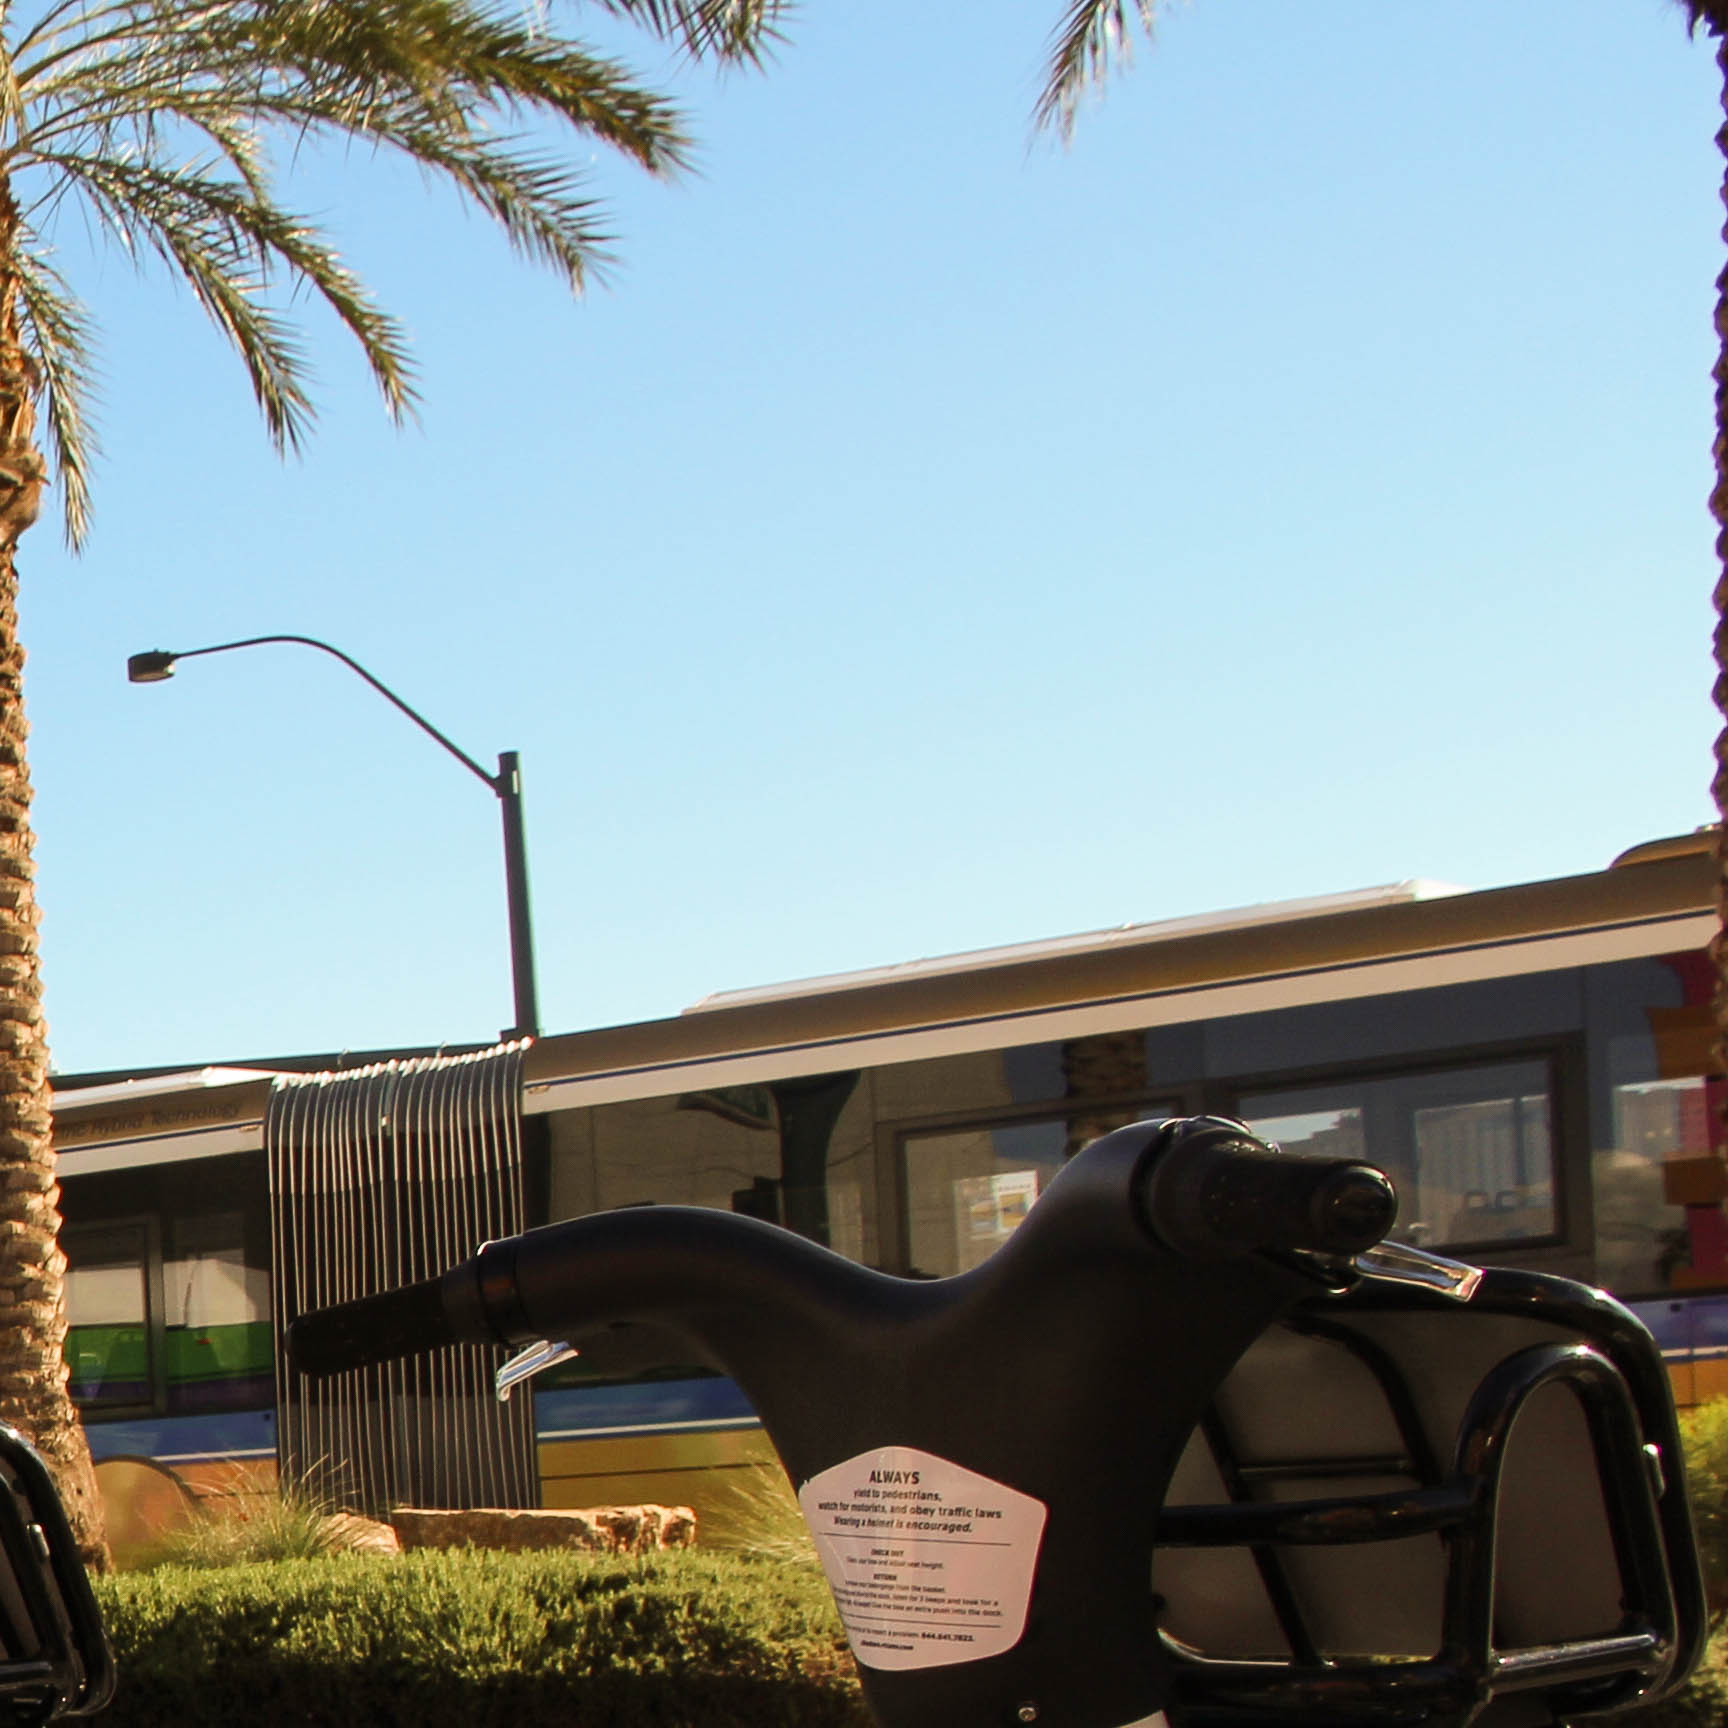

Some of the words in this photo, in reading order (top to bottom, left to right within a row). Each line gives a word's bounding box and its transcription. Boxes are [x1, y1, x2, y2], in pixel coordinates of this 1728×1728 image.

[869, 1471, 920, 1485] ALWAYS
[890, 1505, 908, 1514] and
[909, 1506, 936, 1518] obey
[938, 1506, 972, 1518] traffic
[975, 1508, 1002, 1519] laws
[905, 1521, 973, 1533] encouraged.
